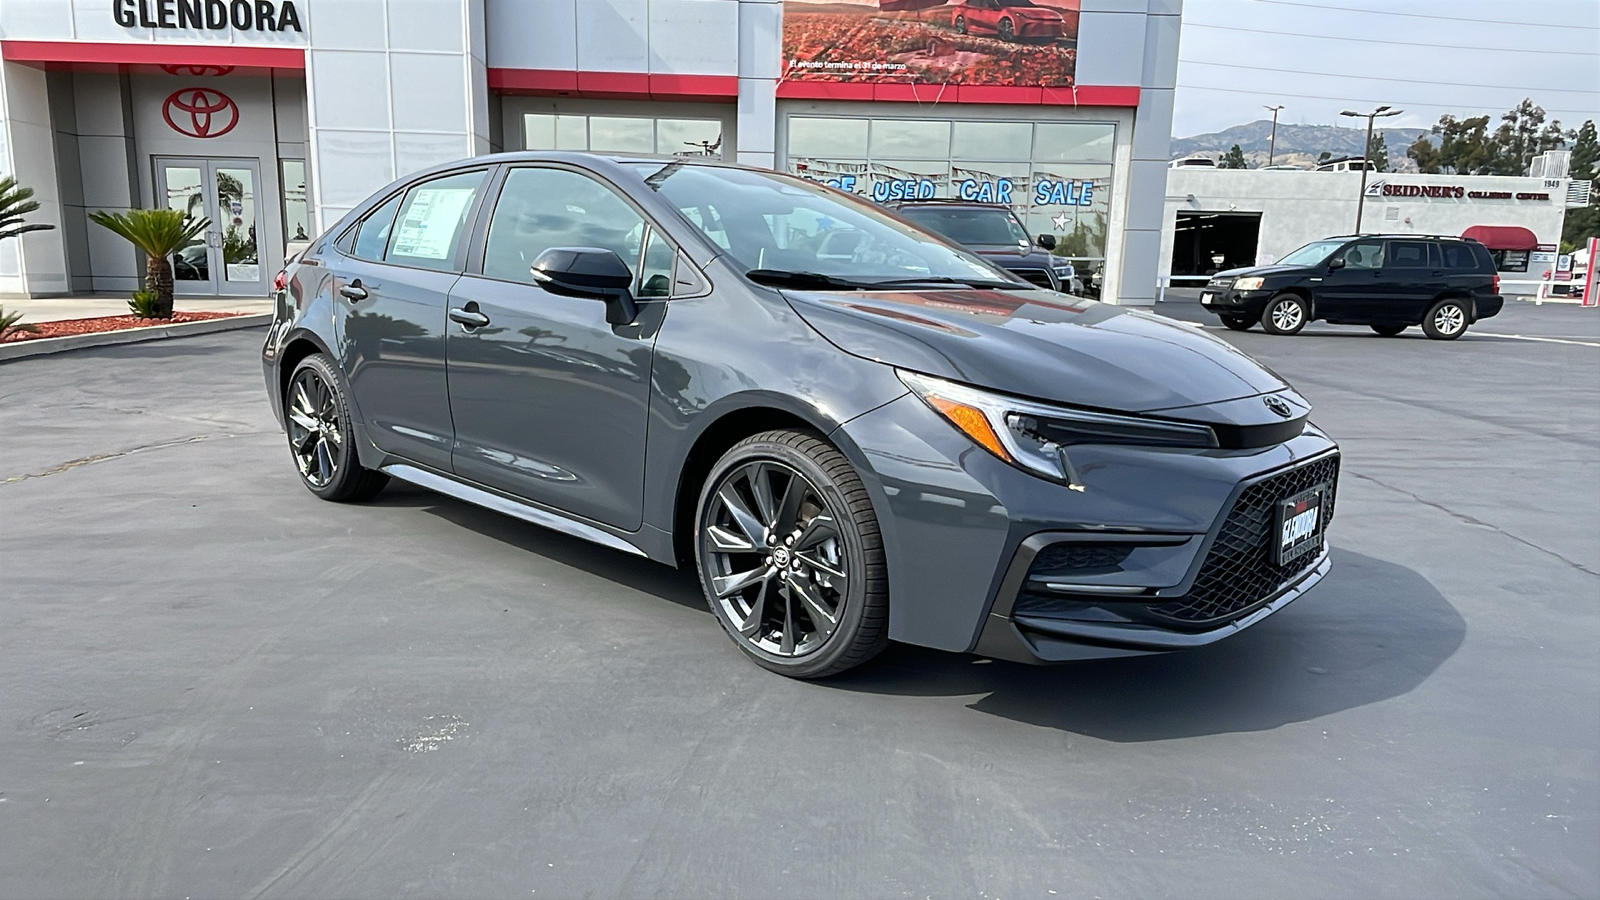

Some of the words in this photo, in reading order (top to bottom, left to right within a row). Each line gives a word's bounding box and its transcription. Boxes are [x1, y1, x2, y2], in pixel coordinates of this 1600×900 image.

[113, 0, 303, 32] GLENDORA
[789, 60, 797, 68] El
[824, 60, 853, 69] termina
[854, 61, 862, 69] el
[862, 61, 872, 69] 31
[872, 61, 881, 70] de
[1382, 184, 1465, 199] SEIDNER'S
[1544, 180, 1560, 188] 1949
[873, 178, 936, 203] USED
[960, 178, 1013, 204] CAR
[1034, 179, 1094, 206] SALE
